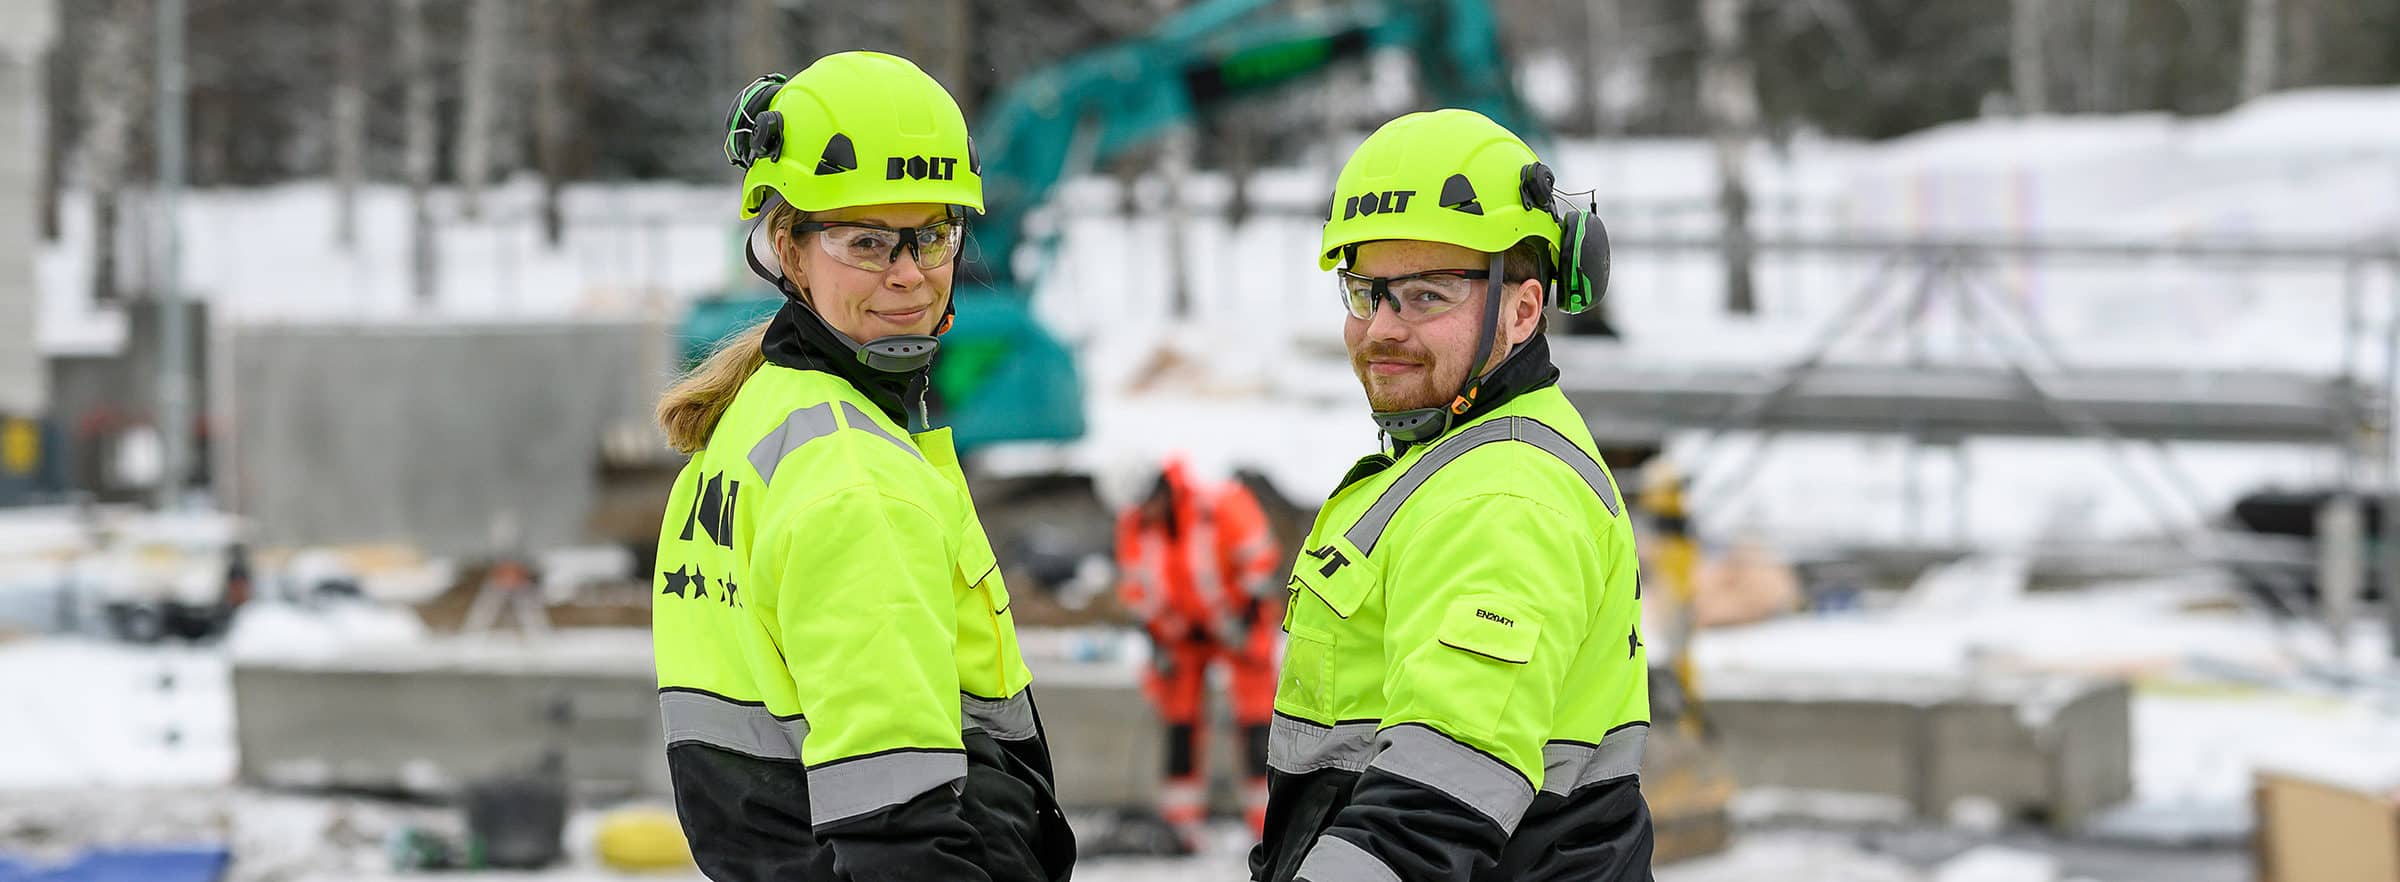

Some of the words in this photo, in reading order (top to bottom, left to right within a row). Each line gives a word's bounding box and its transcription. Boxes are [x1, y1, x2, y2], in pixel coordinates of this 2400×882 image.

[886, 155, 957, 181] BOLT
[1343, 190, 1416, 221] BOLT
[1476, 608, 1514, 628] EN20471
